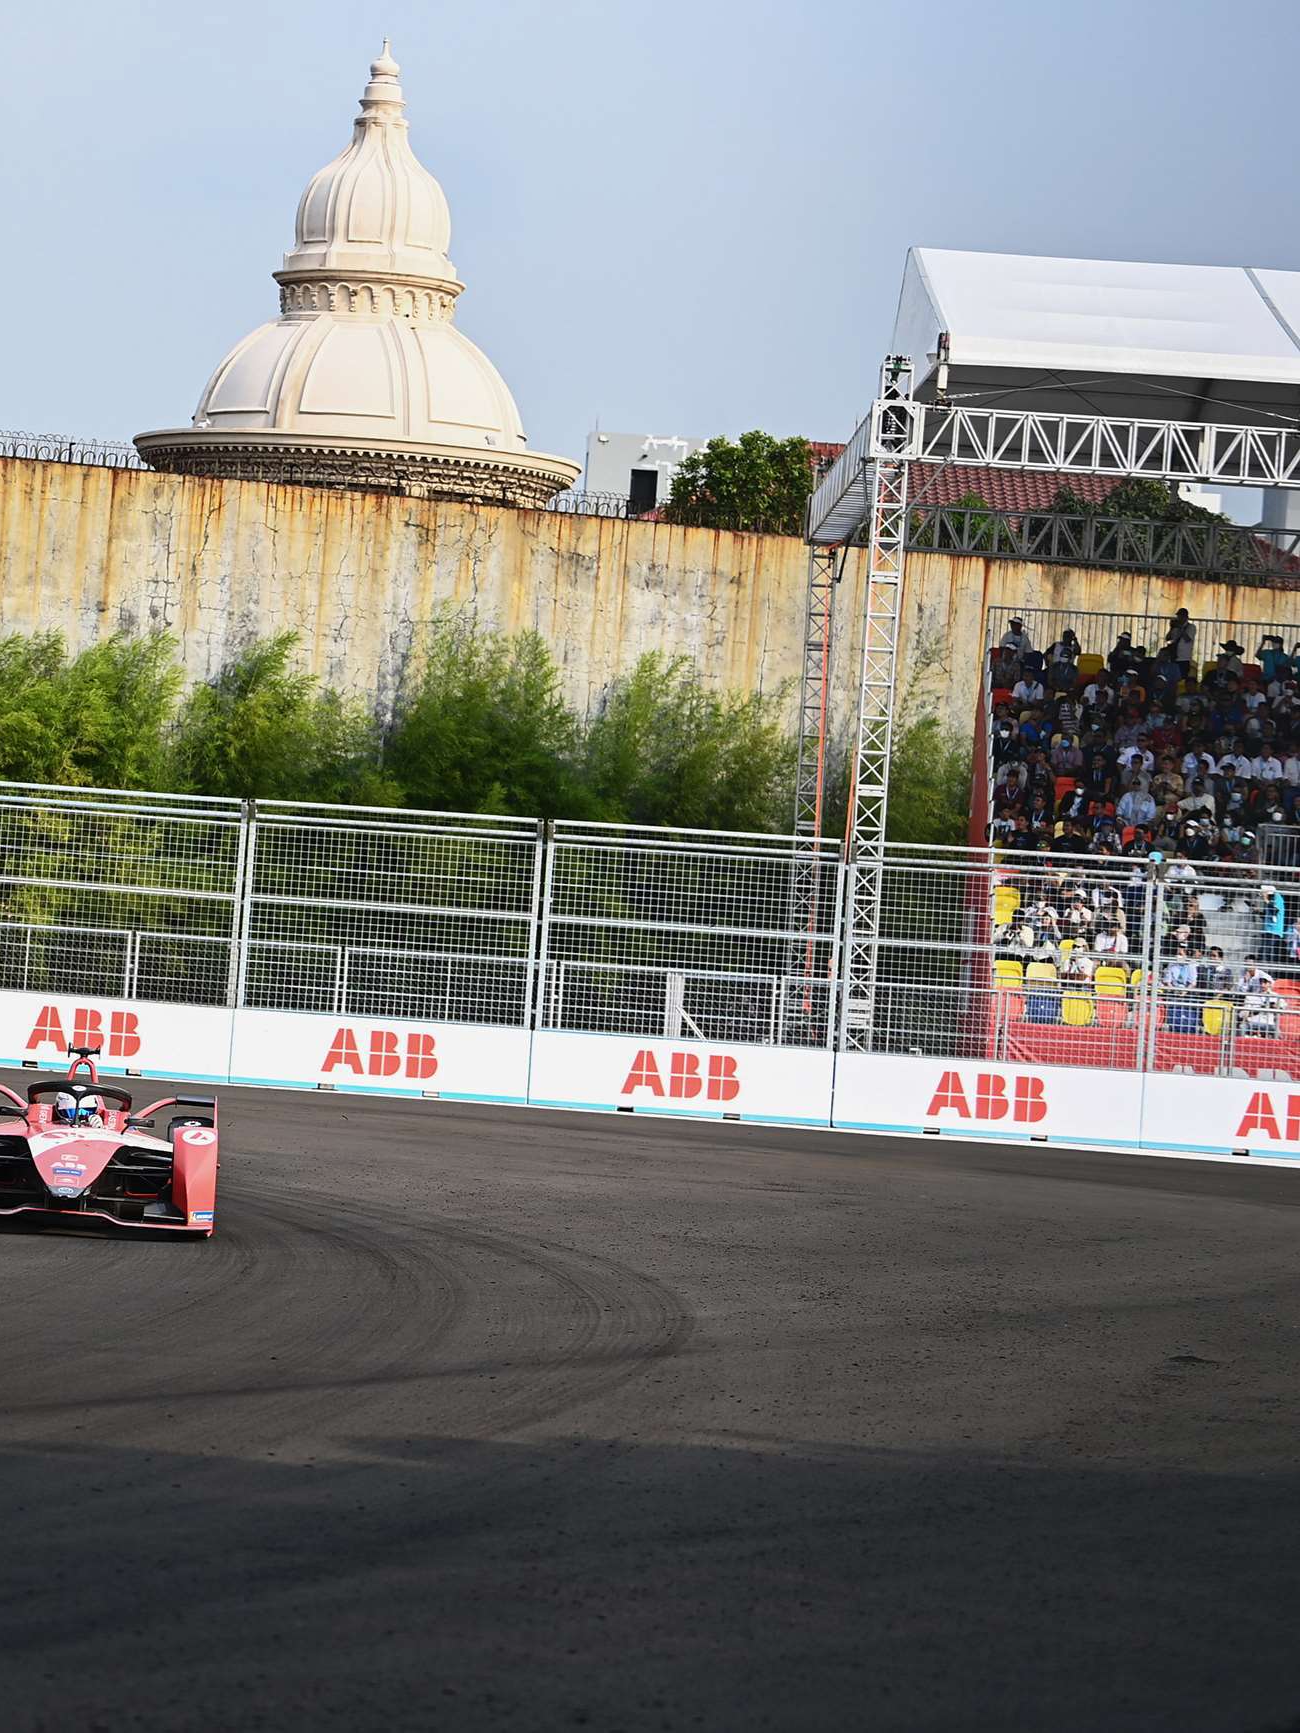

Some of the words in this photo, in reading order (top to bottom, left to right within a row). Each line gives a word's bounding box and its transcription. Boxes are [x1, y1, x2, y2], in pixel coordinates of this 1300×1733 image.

[26, 1006, 141, 1056] ABB
[322, 1028, 438, 1079] ABB
[620, 1050, 741, 1101] ABB
[927, 1071, 1048, 1122] ABB
